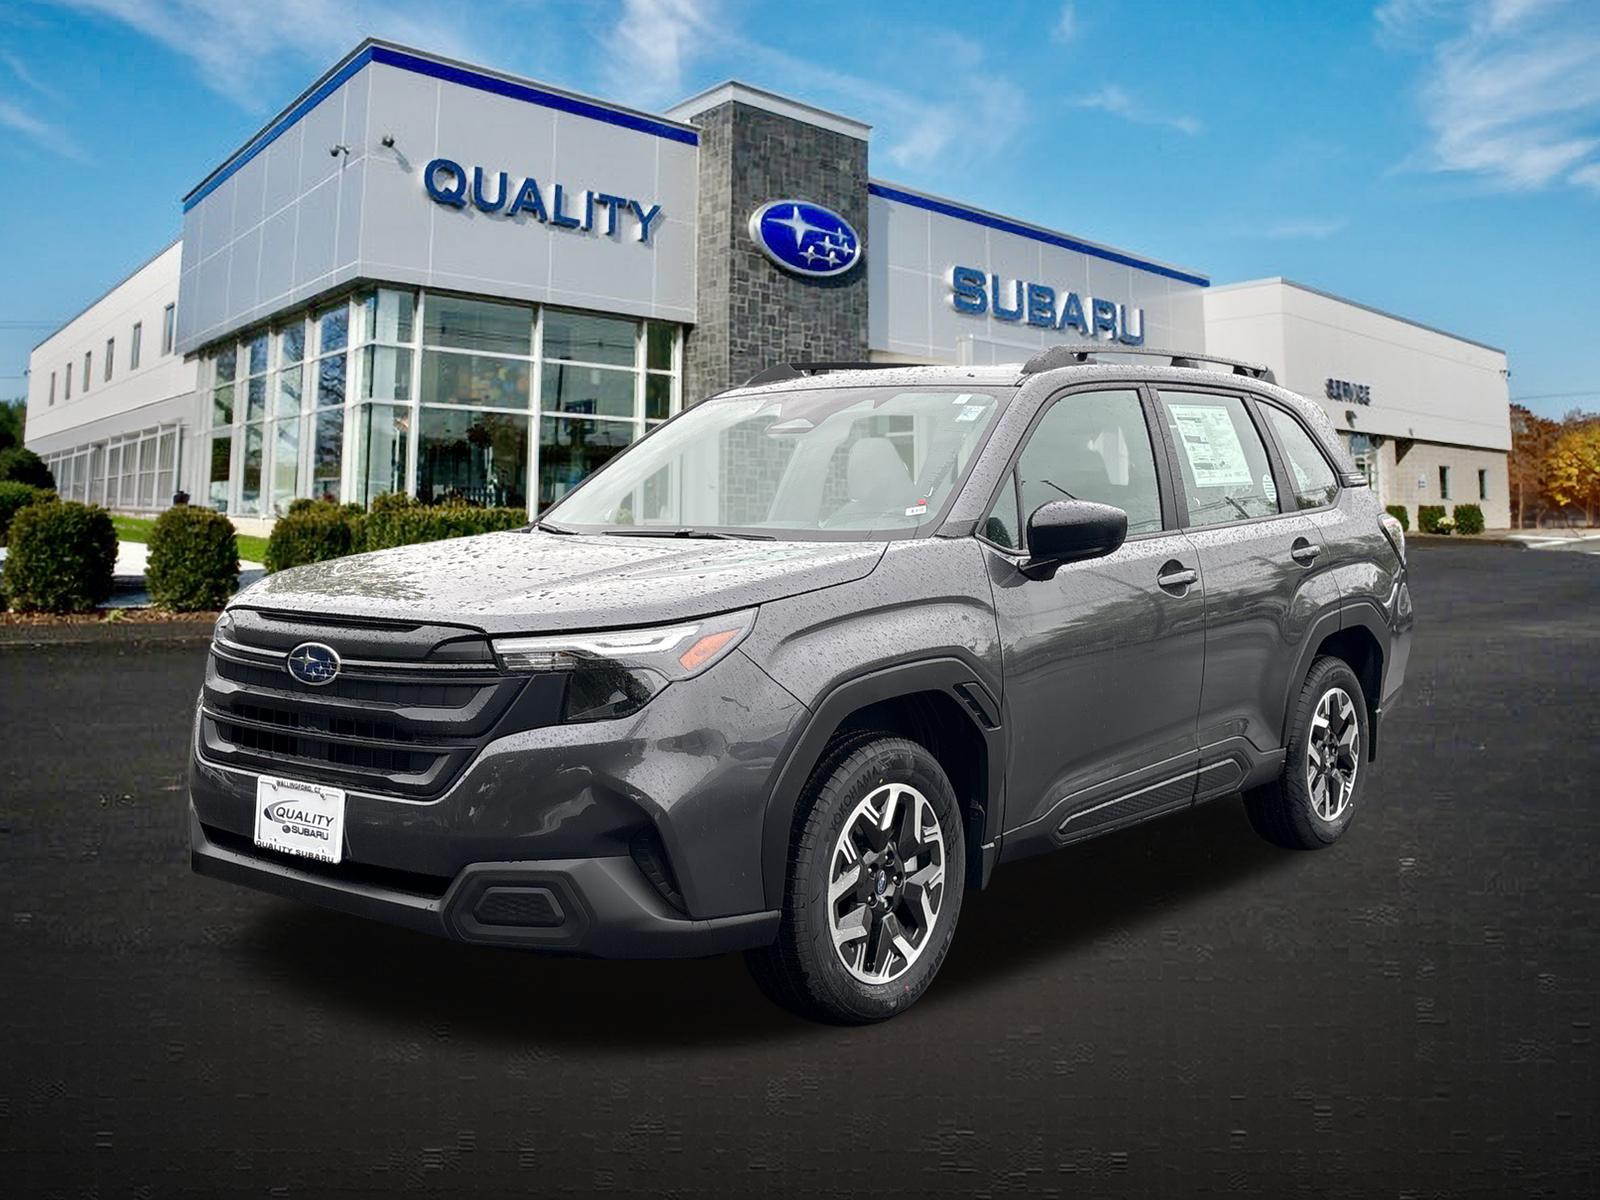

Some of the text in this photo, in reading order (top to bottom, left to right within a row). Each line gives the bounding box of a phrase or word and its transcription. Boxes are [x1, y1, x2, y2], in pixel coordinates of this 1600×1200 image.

[424, 158, 662, 242] QUALITY
[950, 265, 1145, 347] SUBARU
[275, 806, 335, 828] QUALITY
[830, 765, 881, 831] YOKOHAMA
[255, 840, 334, 863] QUALITY SUBARU
[291, 825, 329, 841] SUBARU
